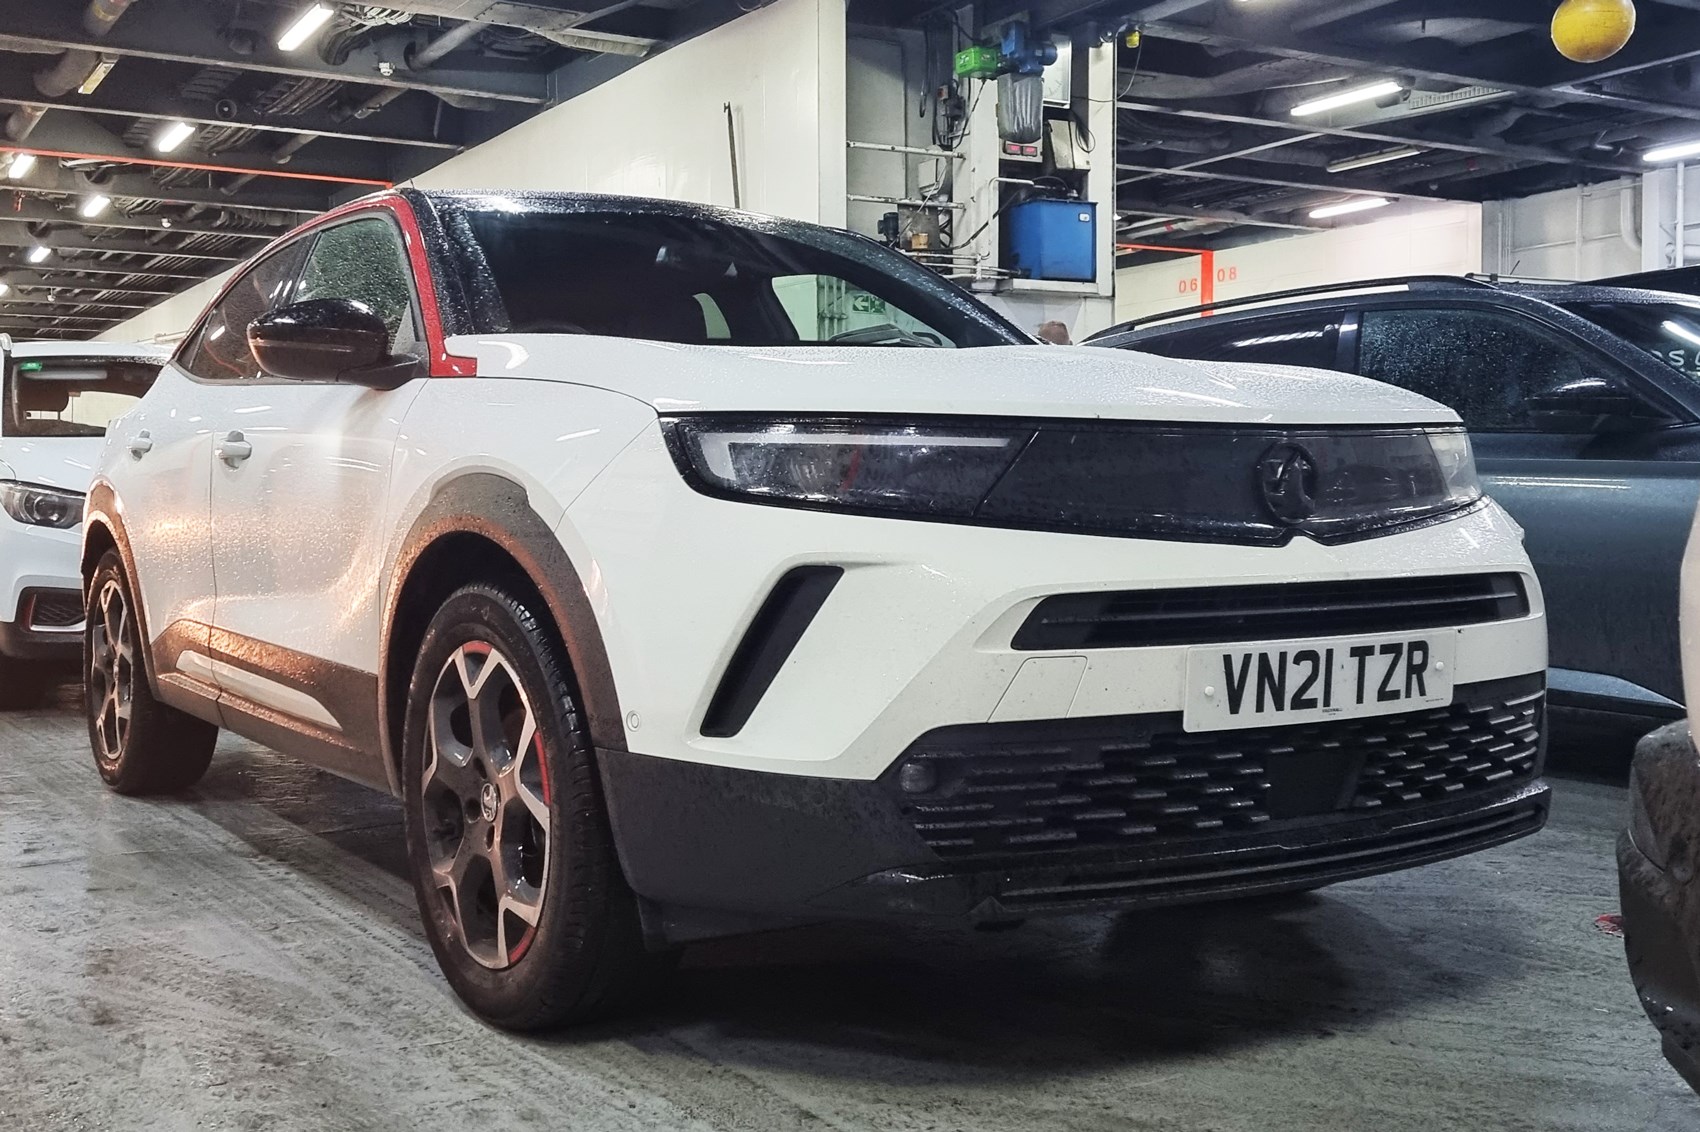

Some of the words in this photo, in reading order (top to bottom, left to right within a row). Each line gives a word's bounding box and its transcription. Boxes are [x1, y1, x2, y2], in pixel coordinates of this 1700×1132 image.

[1217, 267, 1237, 282] 08
[1179, 278, 1198, 293] 06
[1222, 648, 1334, 714] VN21
[1350, 640, 1429, 704] TZR
